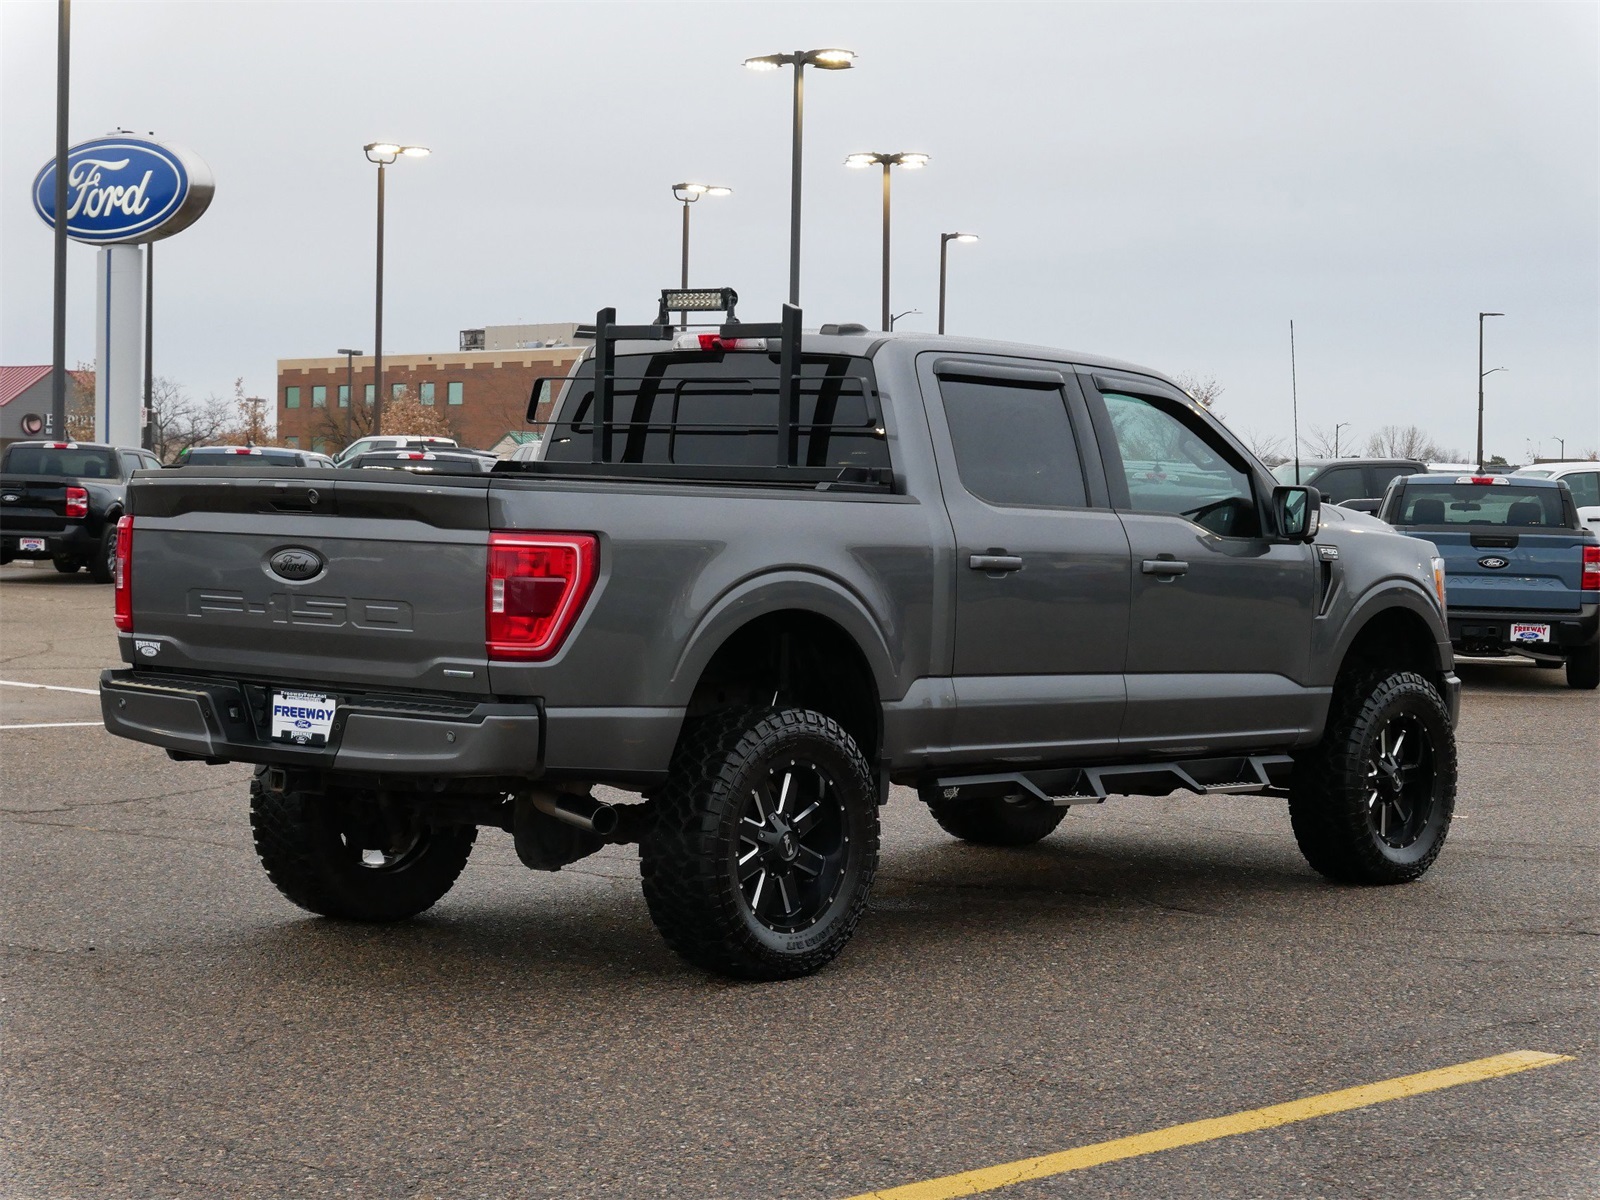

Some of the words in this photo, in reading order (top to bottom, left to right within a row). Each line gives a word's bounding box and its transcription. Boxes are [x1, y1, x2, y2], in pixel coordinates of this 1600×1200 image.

[67, 158, 153, 219] Ford
[279, 554, 309, 572] Ford
[1514, 625, 1547, 636] FREEWAY
[274, 705, 333, 720] FREEWAY
